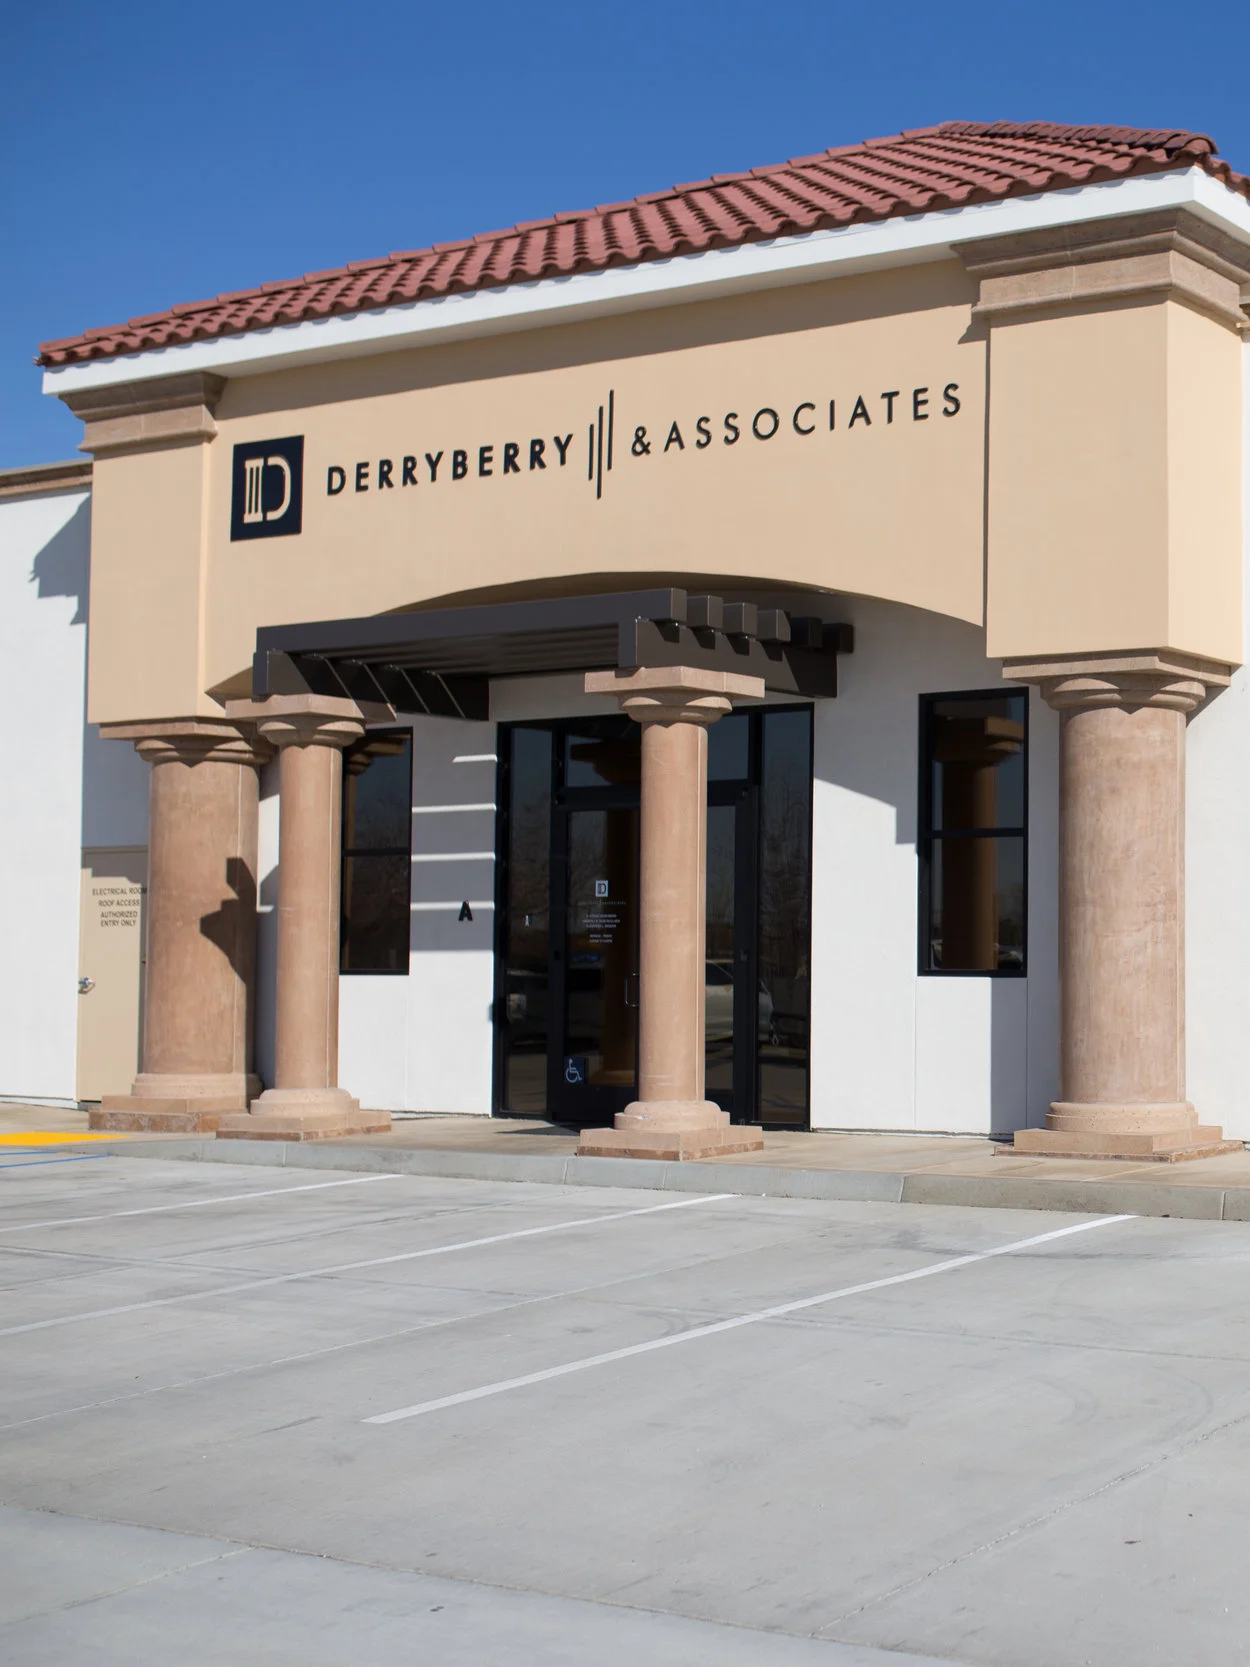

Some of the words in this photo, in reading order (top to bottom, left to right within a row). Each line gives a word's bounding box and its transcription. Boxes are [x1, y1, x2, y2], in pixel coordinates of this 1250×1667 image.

[326, 433, 574, 496] DERRYBERRY
[631, 425, 651, 457] &
[663, 382, 961, 453] ASSOCIATES
[92, 887, 127, 896] ELECTRICAL
[98, 899, 114, 907] ROOF
[116, 899, 140, 907] ACCESS
[100, 911, 138, 919] AUTHORIZED
[458, 900, 473, 921] A
[100, 920, 119, 928] ENTRY
[121, 919, 136, 927] ONLY
